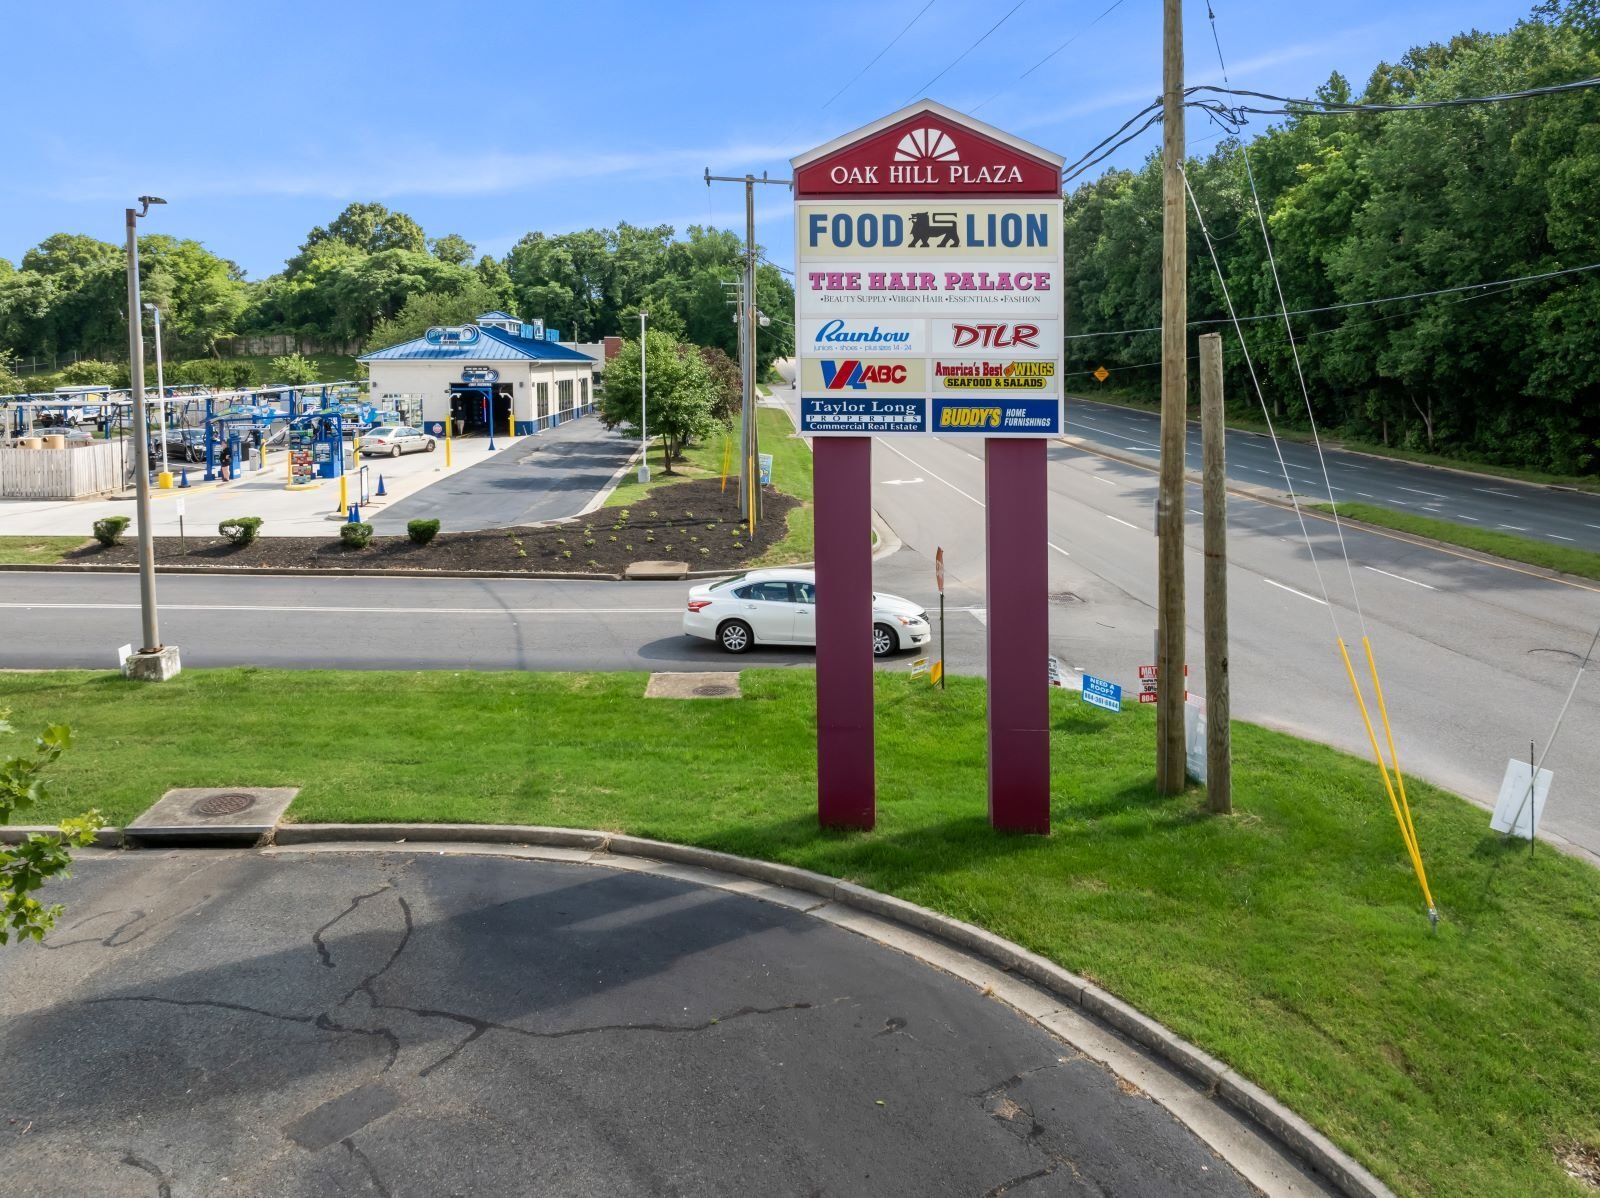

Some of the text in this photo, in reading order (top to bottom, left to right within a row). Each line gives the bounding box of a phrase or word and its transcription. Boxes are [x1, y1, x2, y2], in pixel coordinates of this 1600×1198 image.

[831, 165, 1023, 185] OAK HILL PLAZA
[809, 213, 1048, 248] FOOD LION
[808, 272, 1051, 291] THE HAIR PALACE
[823, 294, 1041, 303] BEAUTY SUPPLY VIRGIN HAIR ESSENTIALS FASHION
[815, 319, 910, 342] Rainbow
[952, 323, 1040, 349] DTLR
[813, 344, 834, 353] juniors
[858, 364, 907, 384] ABC
[935, 361, 1055, 377] America's Best WINGS
[947, 378, 1043, 387] SEAFOOD & SALADS
[810, 400, 917, 415] Taylor Long
[1006, 408, 1027, 417] HOME
[940, 407, 1002, 427] BUDDY'S
[1004, 418, 1051, 427] FURNISHINGS
[809, 422, 918, 430] Commercial Real Estate
[1089, 677, 1108, 688] NEED
[1090, 683, 1114, 696] ROOF?
